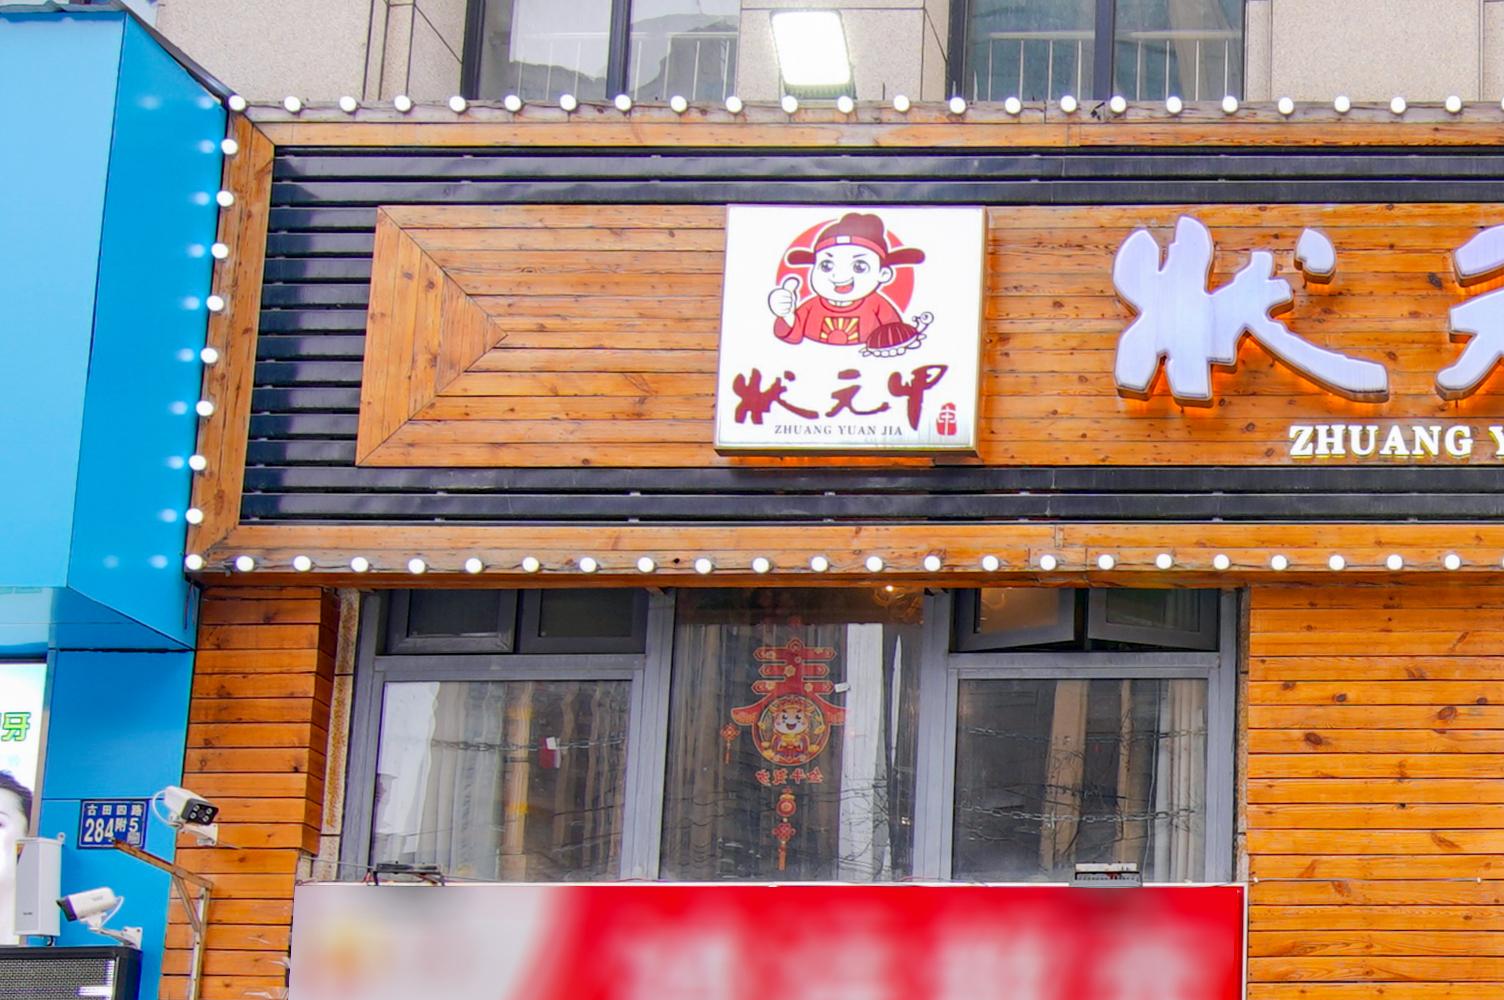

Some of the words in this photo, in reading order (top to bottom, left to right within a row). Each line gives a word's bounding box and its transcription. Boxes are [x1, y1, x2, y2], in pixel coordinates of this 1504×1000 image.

[732, 365, 949, 432] 状元甲
[774, 425, 832, 436] ZHUANG
[839, 425, 877, 436] YUAN
[882, 426, 903, 437] JIA
[1288, 424, 1474, 458] ZHUANG
